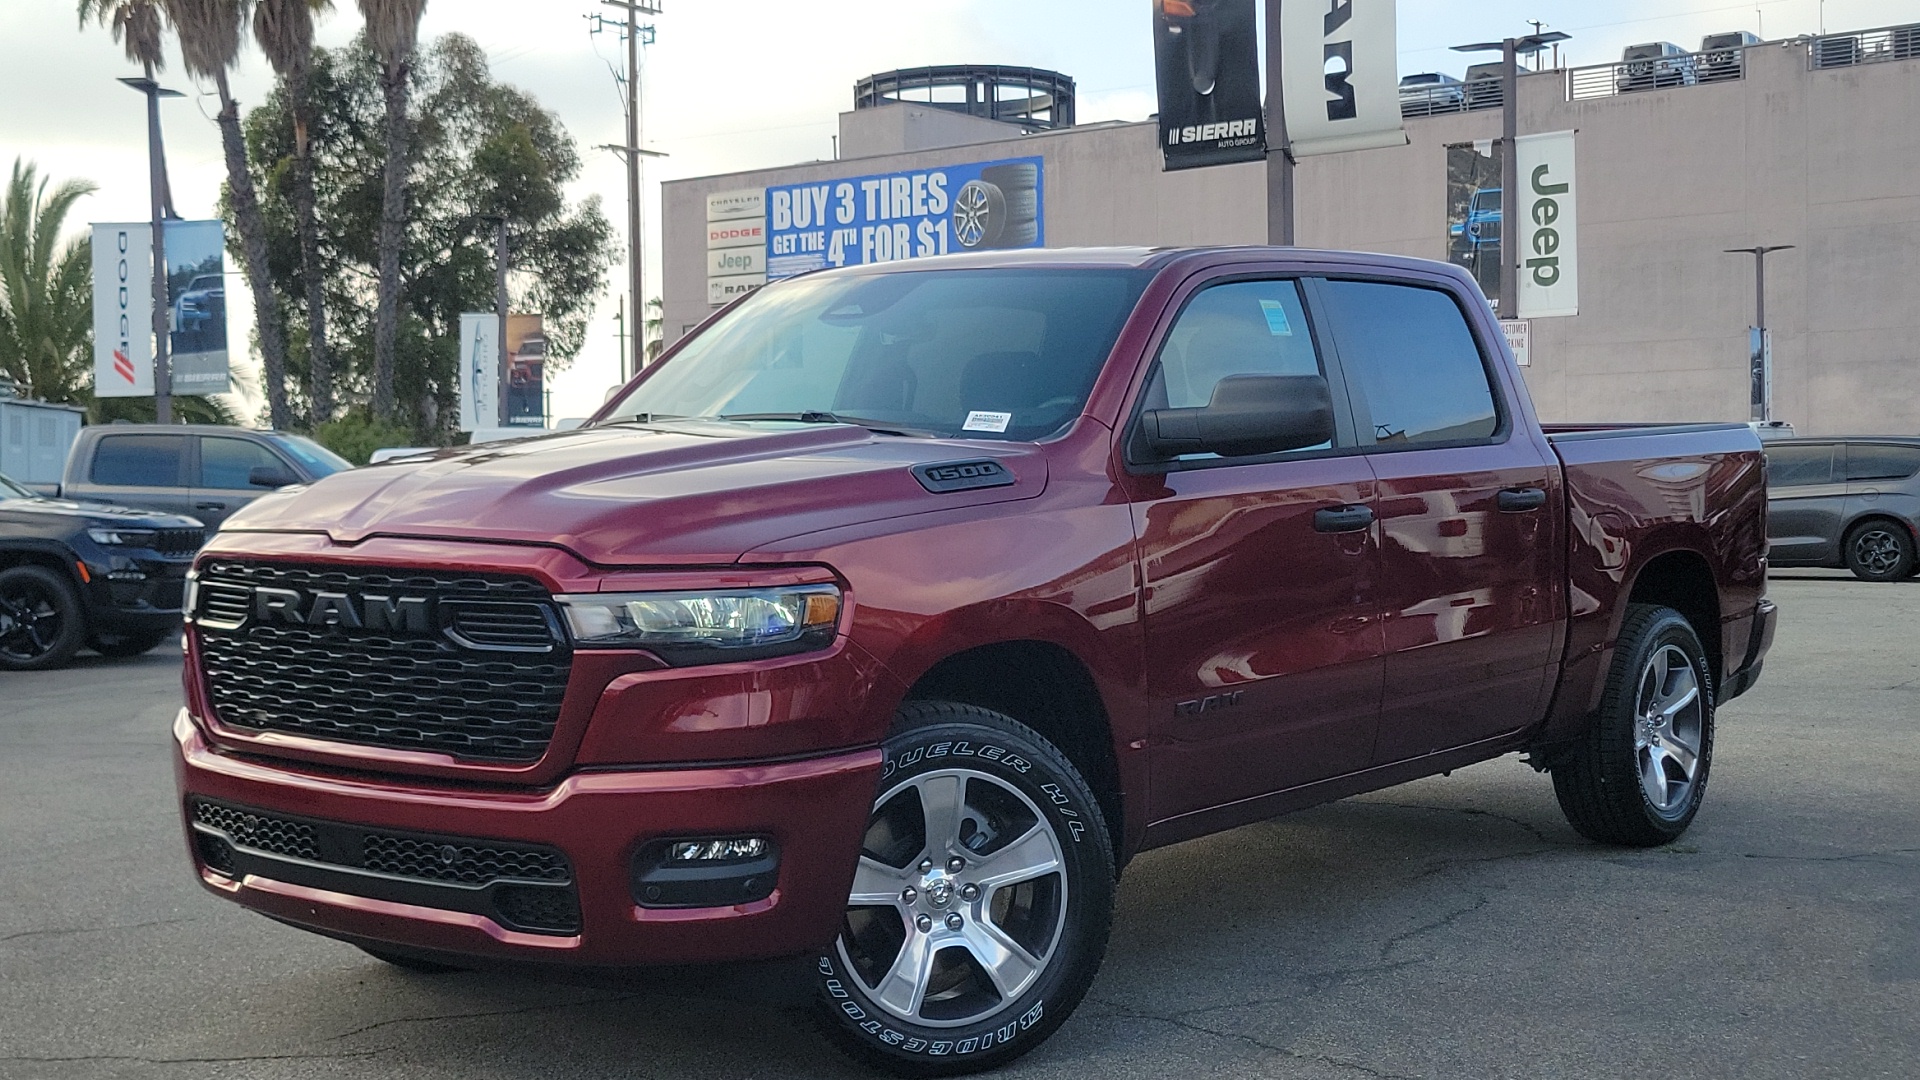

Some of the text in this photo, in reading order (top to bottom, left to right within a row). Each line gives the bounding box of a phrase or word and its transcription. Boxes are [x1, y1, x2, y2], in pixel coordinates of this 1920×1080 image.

[1323, 0, 1357, 122] AM
[1181, 118, 1257, 143] SIERRA
[1217, 137, 1257, 149] AUTO GROUP
[772, 171, 949, 231] BUY 3 TIRES
[710, 227, 762, 241] DODGE
[773, 233, 798, 255] GET
[799, 230, 825, 253] THE
[862, 223, 911, 265] FOR
[916, 217, 948, 259] $1
[1526, 163, 1569, 287] Jeep
[717, 252, 753, 271] Jeep
[118, 231, 130, 362] DODGE
[1500, 323, 1528, 335] USTOMER
[1506, 338, 1525, 349] RKING
[928, 463, 998, 481] 1500
[253, 586, 428, 634] RAM
[818, 956, 1044, 1056] BRIDGESTONE
